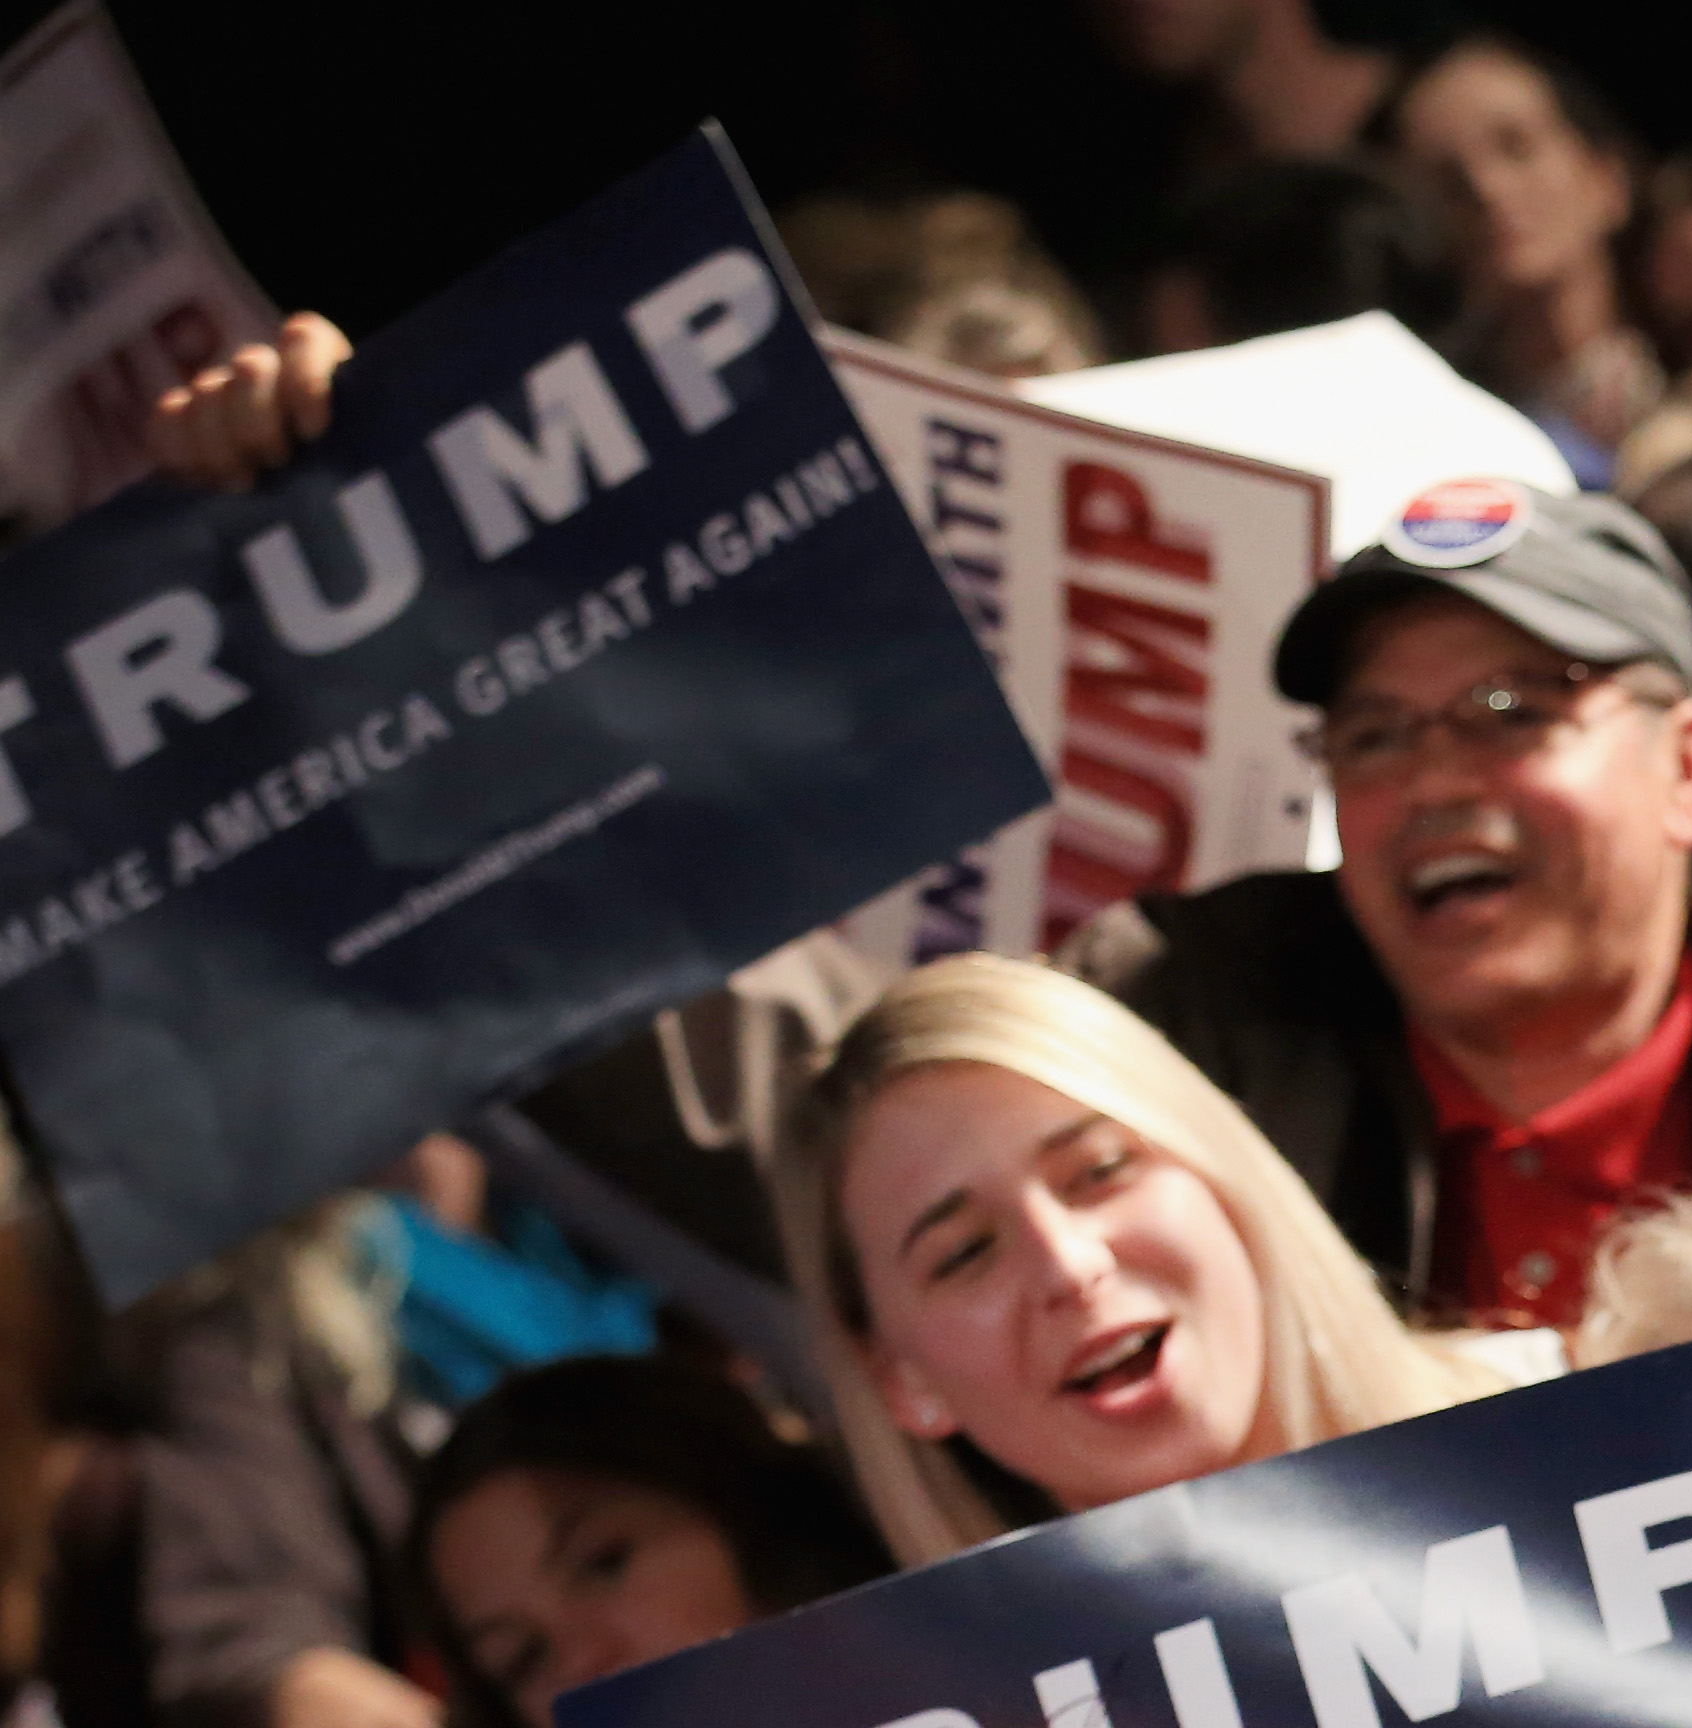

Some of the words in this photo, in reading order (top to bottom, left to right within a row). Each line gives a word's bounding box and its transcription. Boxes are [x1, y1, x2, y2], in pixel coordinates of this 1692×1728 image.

[169, 692, 453, 888] AMERICA
[454, 566, 652, 717] GREAT
[663, 435, 878, 607] AGAIN!
[926, 414, 1004, 630] ITH
